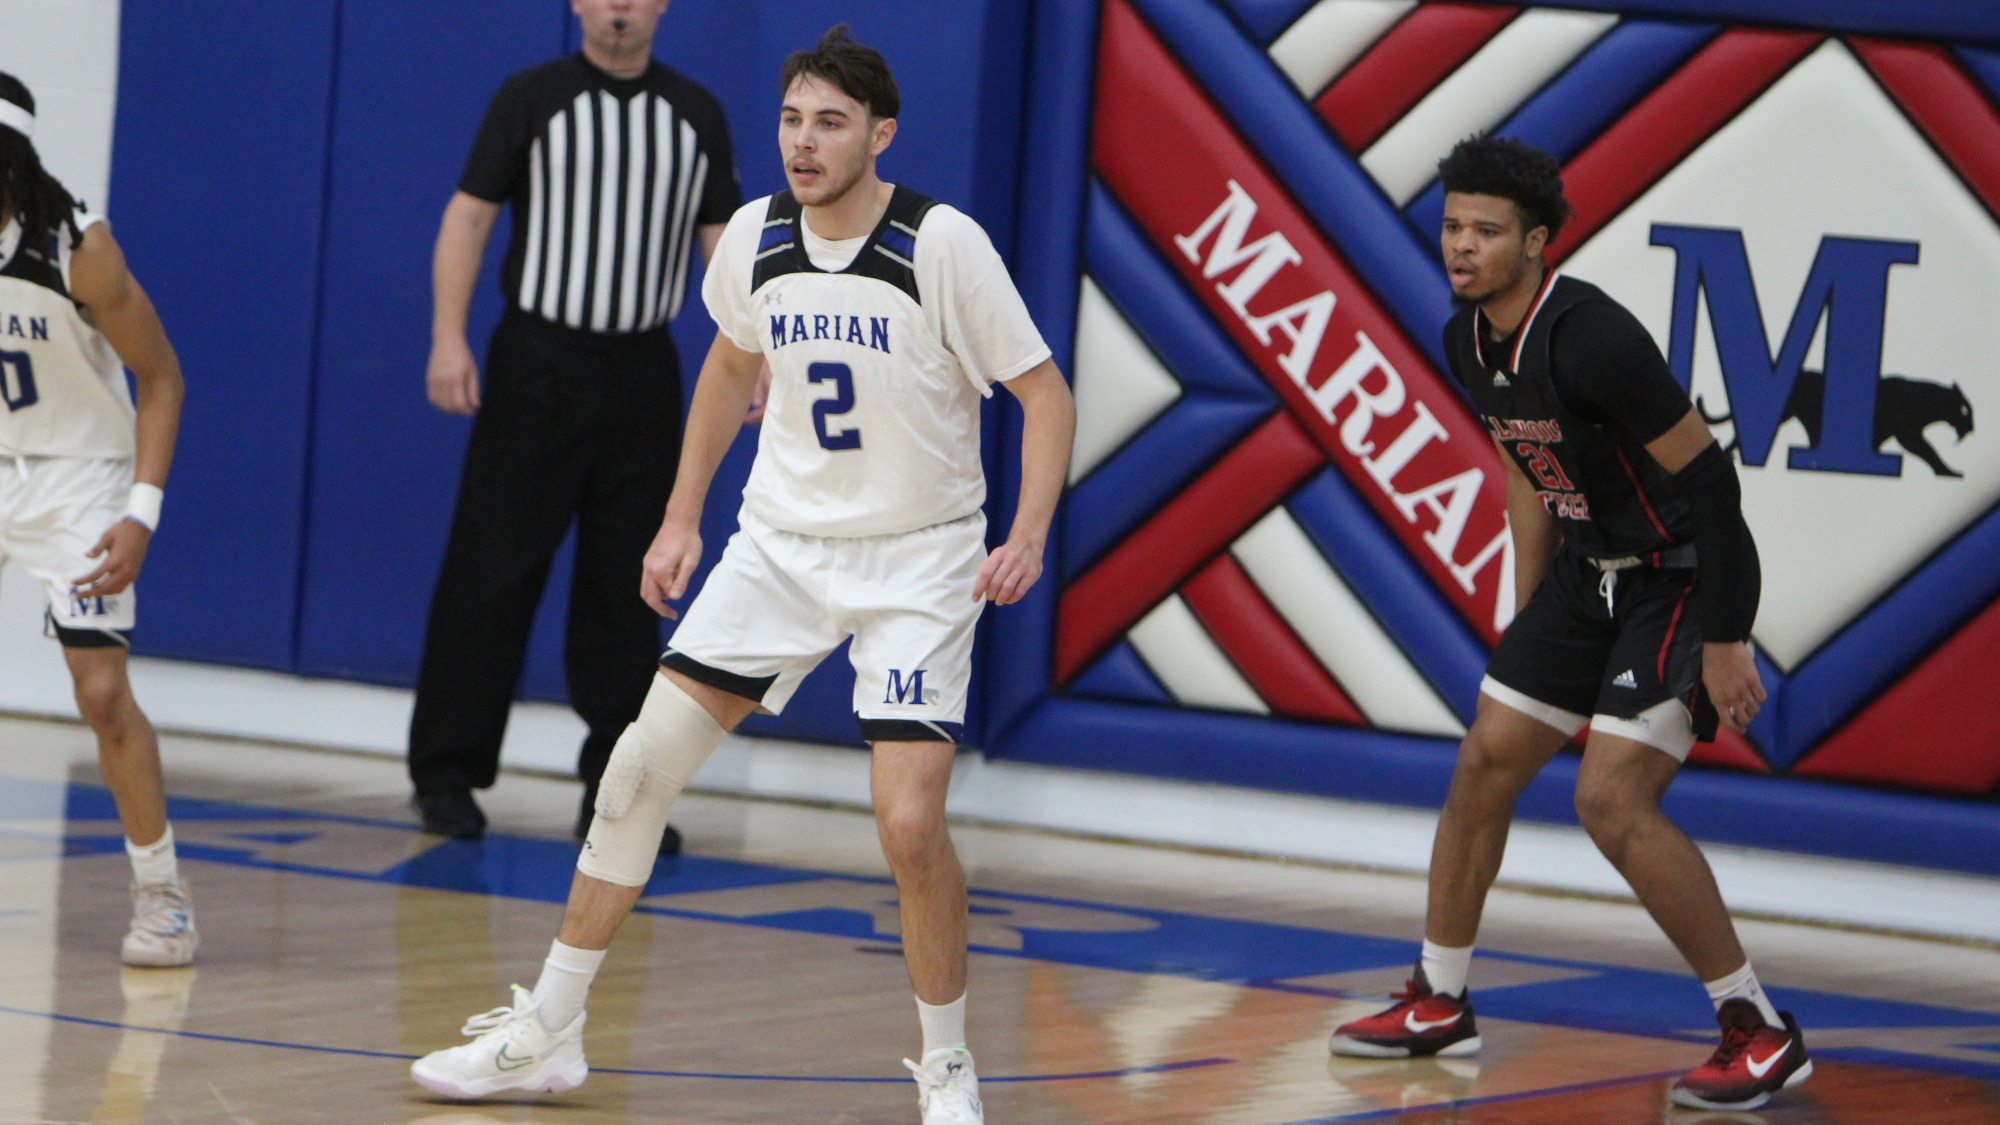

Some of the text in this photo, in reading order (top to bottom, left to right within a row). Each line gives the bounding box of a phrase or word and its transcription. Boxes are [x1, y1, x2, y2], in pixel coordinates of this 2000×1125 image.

[770, 314, 891, 354] MARIAN
[1649, 222, 1921, 478] M
[807, 361, 863, 452] 2
[1517, 442, 1575, 490] 21
[882, 668, 928, 705] M
